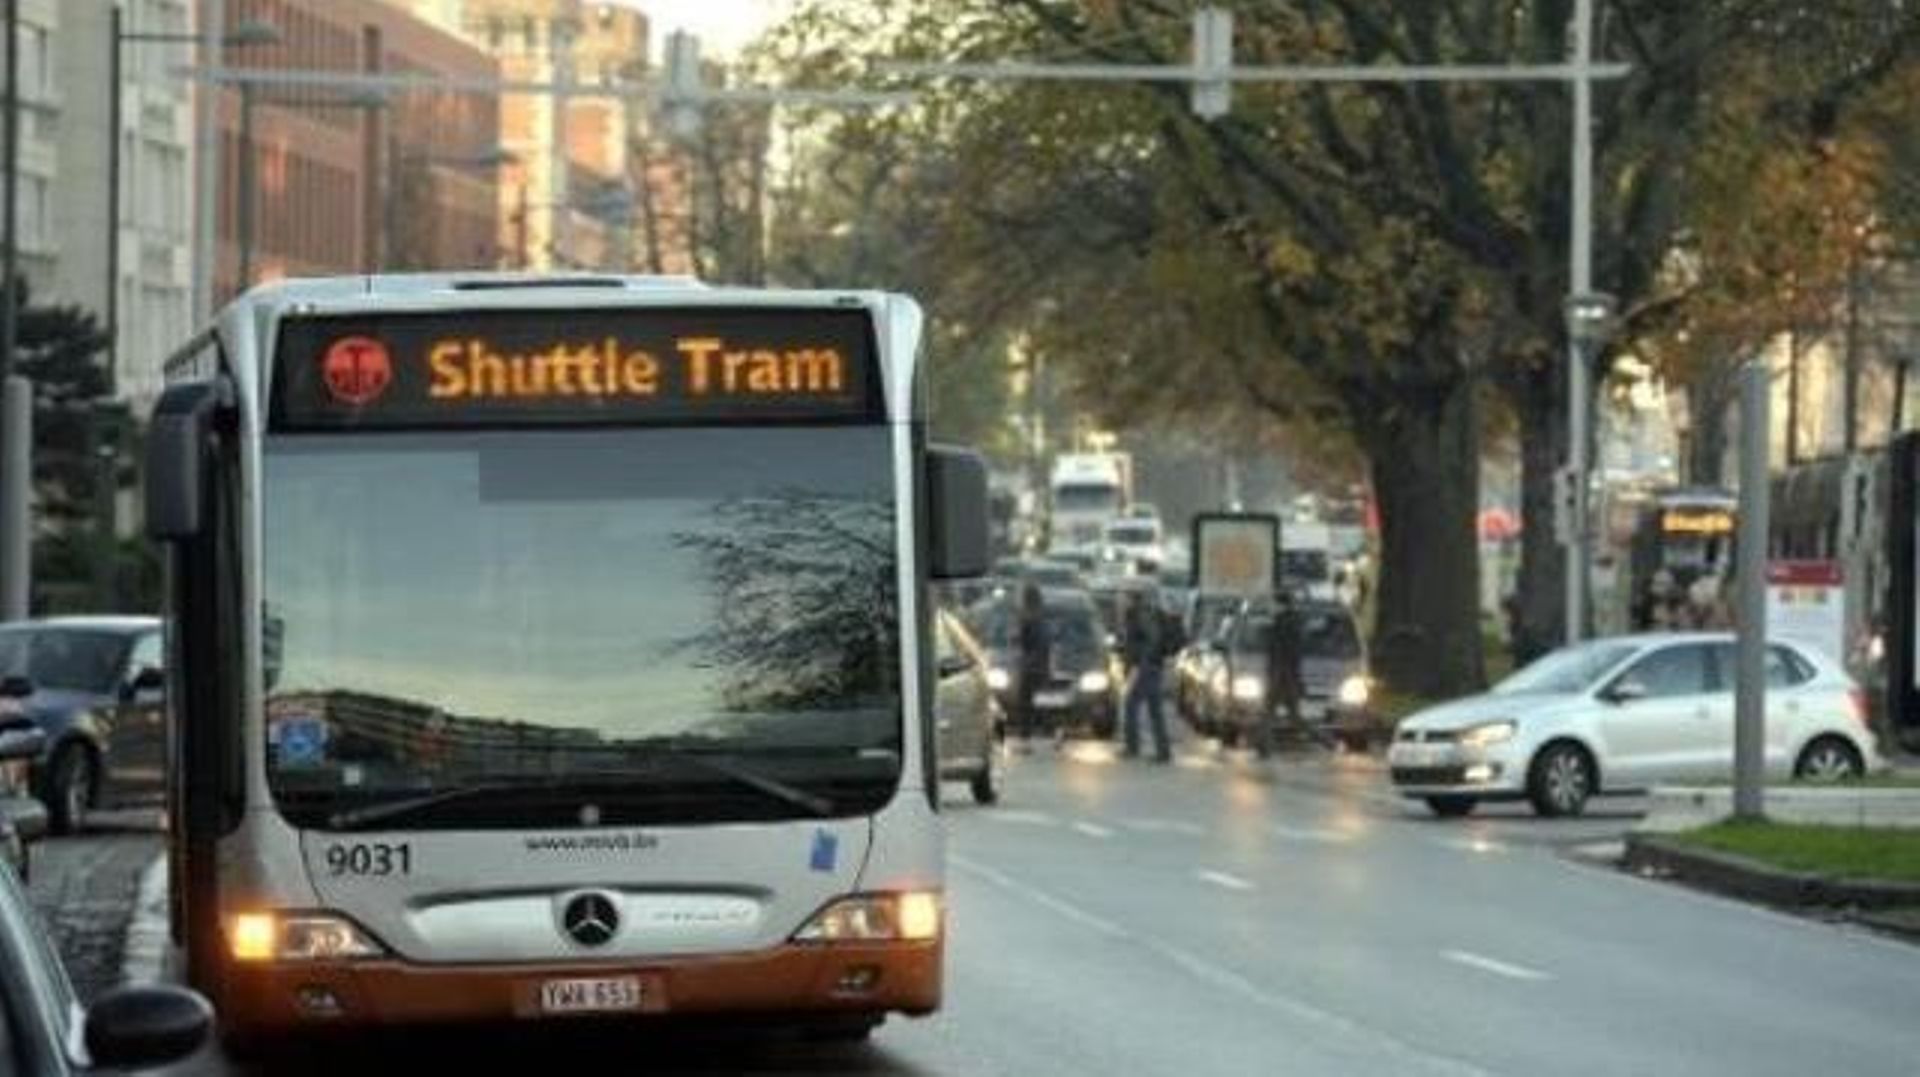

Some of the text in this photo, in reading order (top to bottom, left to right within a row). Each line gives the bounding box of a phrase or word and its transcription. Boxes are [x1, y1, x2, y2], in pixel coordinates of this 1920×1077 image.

[427, 337, 842, 397] Shuttle Tram
[327, 842, 411, 876] 9031
